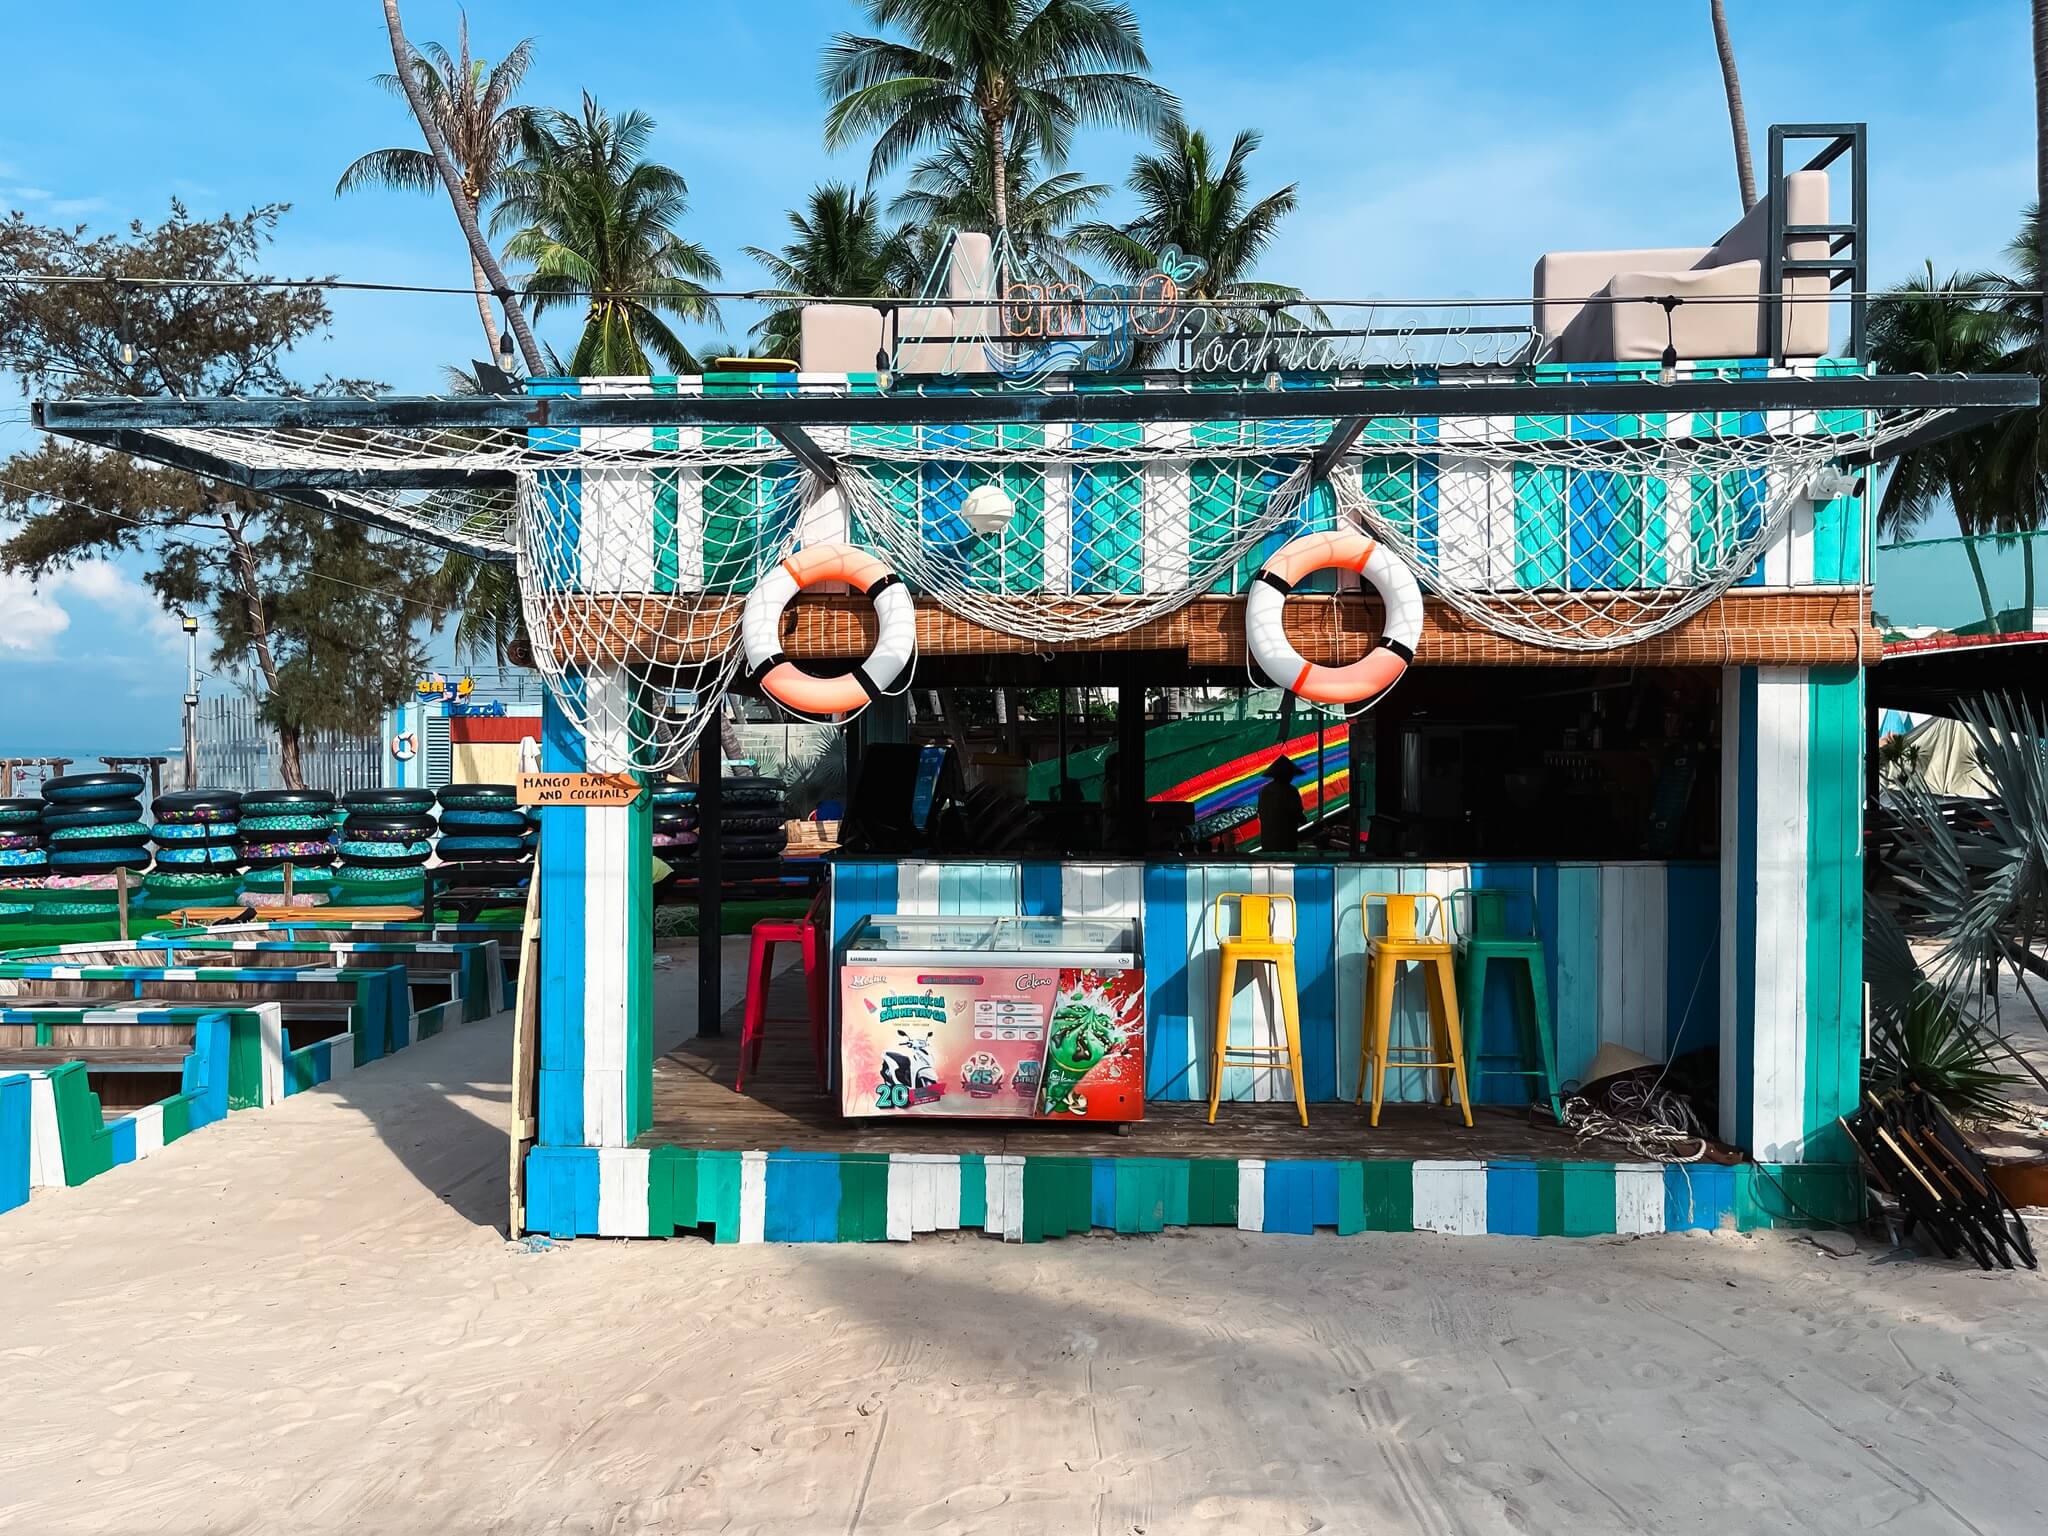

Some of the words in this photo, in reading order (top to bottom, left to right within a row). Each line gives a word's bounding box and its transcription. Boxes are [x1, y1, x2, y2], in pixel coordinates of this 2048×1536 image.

[890, 228, 1178, 376] Mango
[1435, 302, 1553, 371] Beer
[523, 777, 570, 789] MANGO
[579, 777, 606, 788] BAR
[538, 789, 562, 801] AND
[570, 788, 629, 800] COCKTAILS
[1015, 973, 1053, 991] Celano
[970, 1069, 993, 1085] 65
[876, 1084, 909, 1108] 20
